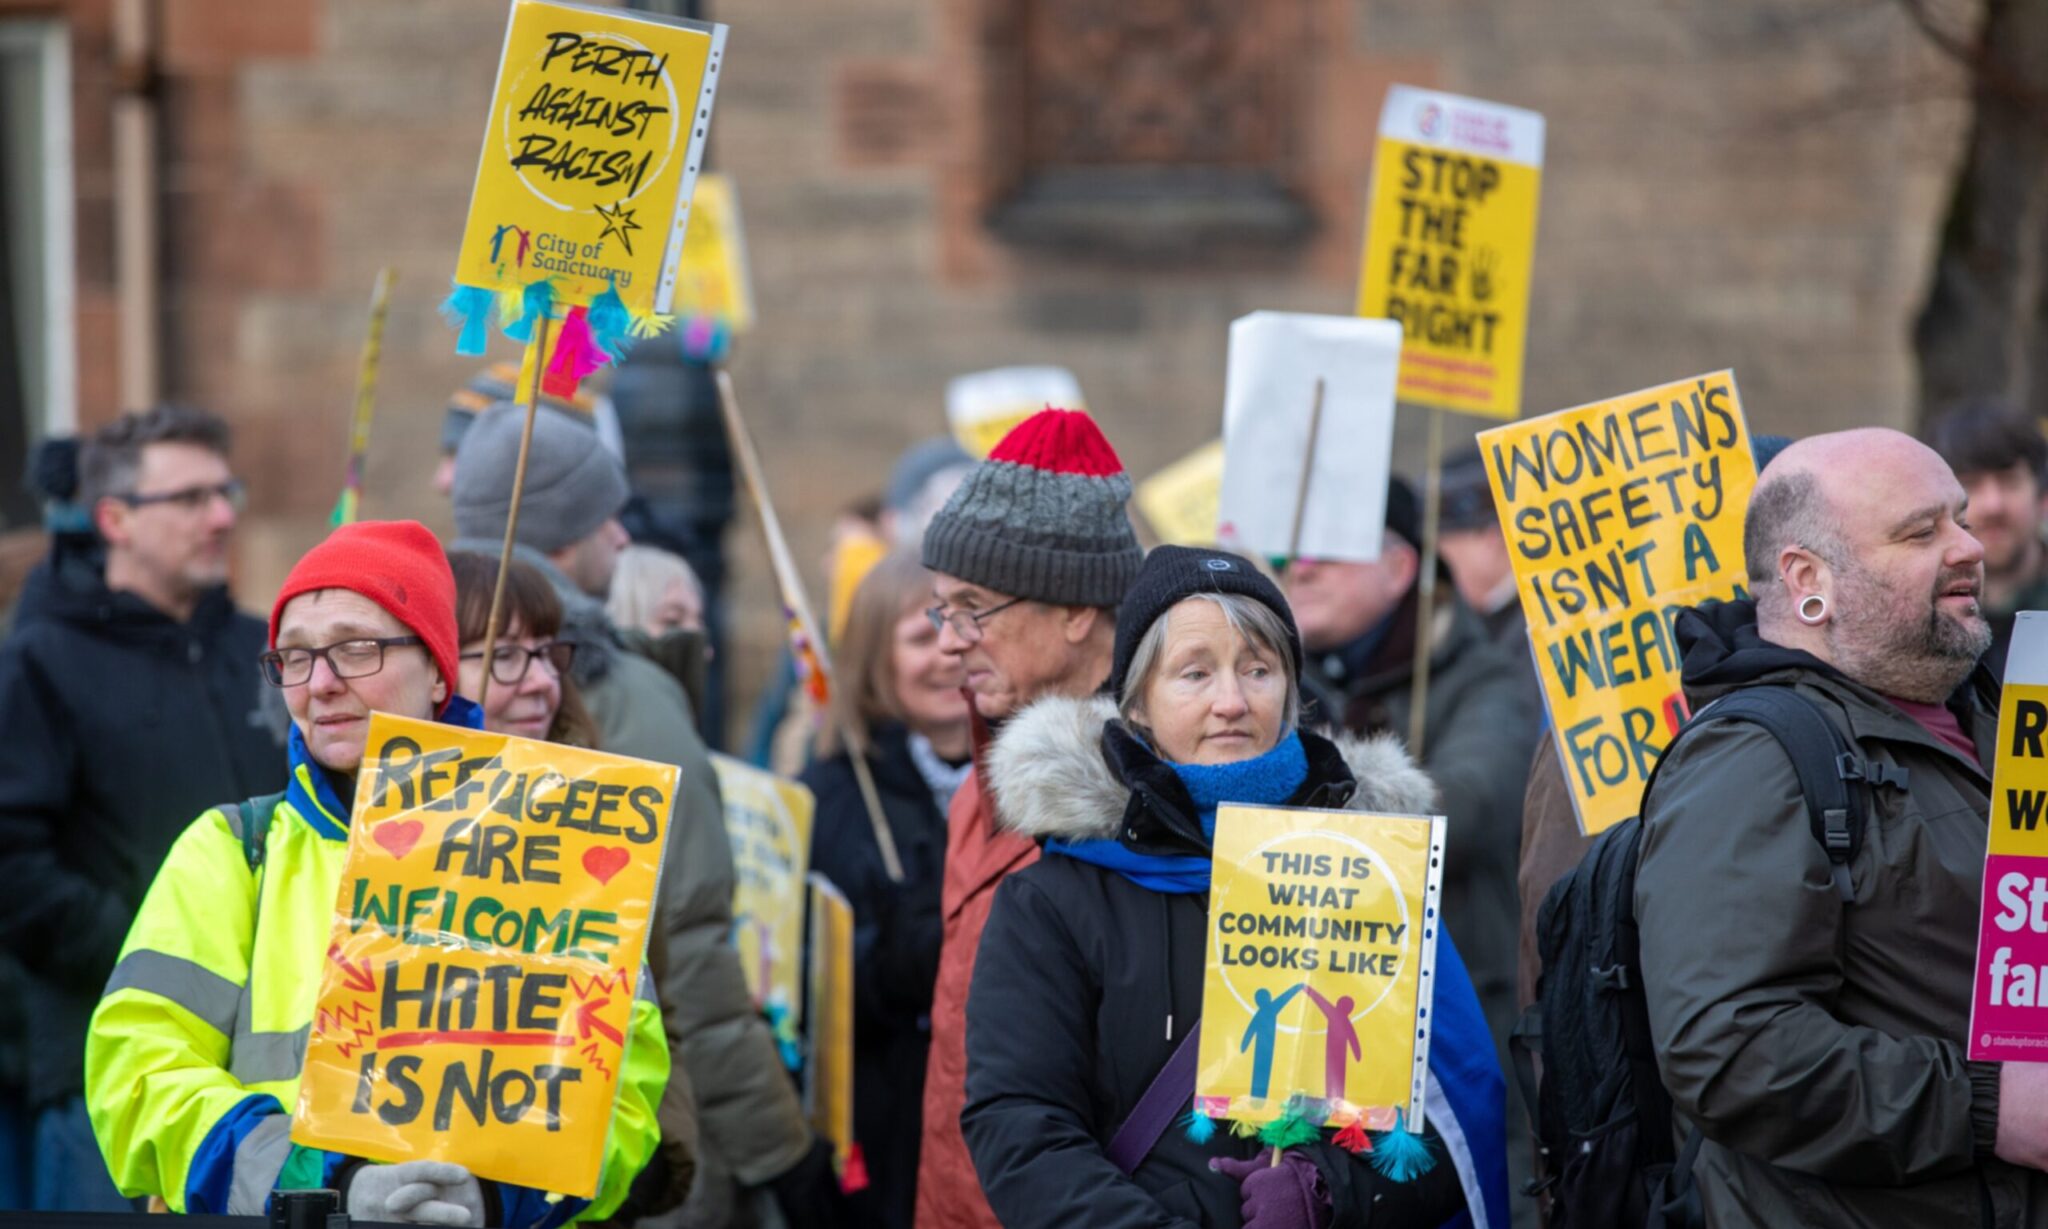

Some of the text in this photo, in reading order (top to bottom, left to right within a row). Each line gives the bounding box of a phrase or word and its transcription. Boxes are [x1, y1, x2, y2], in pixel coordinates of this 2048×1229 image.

[541, 32, 669, 90] PERTH
[519, 84, 669, 140] AGAINST
[511, 134, 653, 198] RACISM
[1401, 149, 1502, 203] STOP
[536, 232, 604, 260] City of
[1398, 197, 1470, 250] THE
[532, 251, 633, 288] Sanctuary
[1389, 245, 1458, 297] FAR
[1387, 297, 1501, 353] RIGHT
[1492, 380, 1738, 502] WOMEN'S
[1514, 455, 1723, 560] SAFETY
[1532, 523, 1720, 626] ISN'T A
[1564, 707, 1663, 797] FOR
[368, 735, 664, 845] REFUGEES
[433, 817, 562, 884] ARE
[1261, 851, 1371, 879] THIS IS
[350, 878, 619, 963] WELCOME
[1267, 883, 1360, 910] WHAT
[1218, 912, 1406, 945] COMMUNITY
[1222, 943, 1398, 977] LOOKS LIKE
[380, 960, 570, 1031] HATE
[351, 1049, 583, 1132] IS NOT
